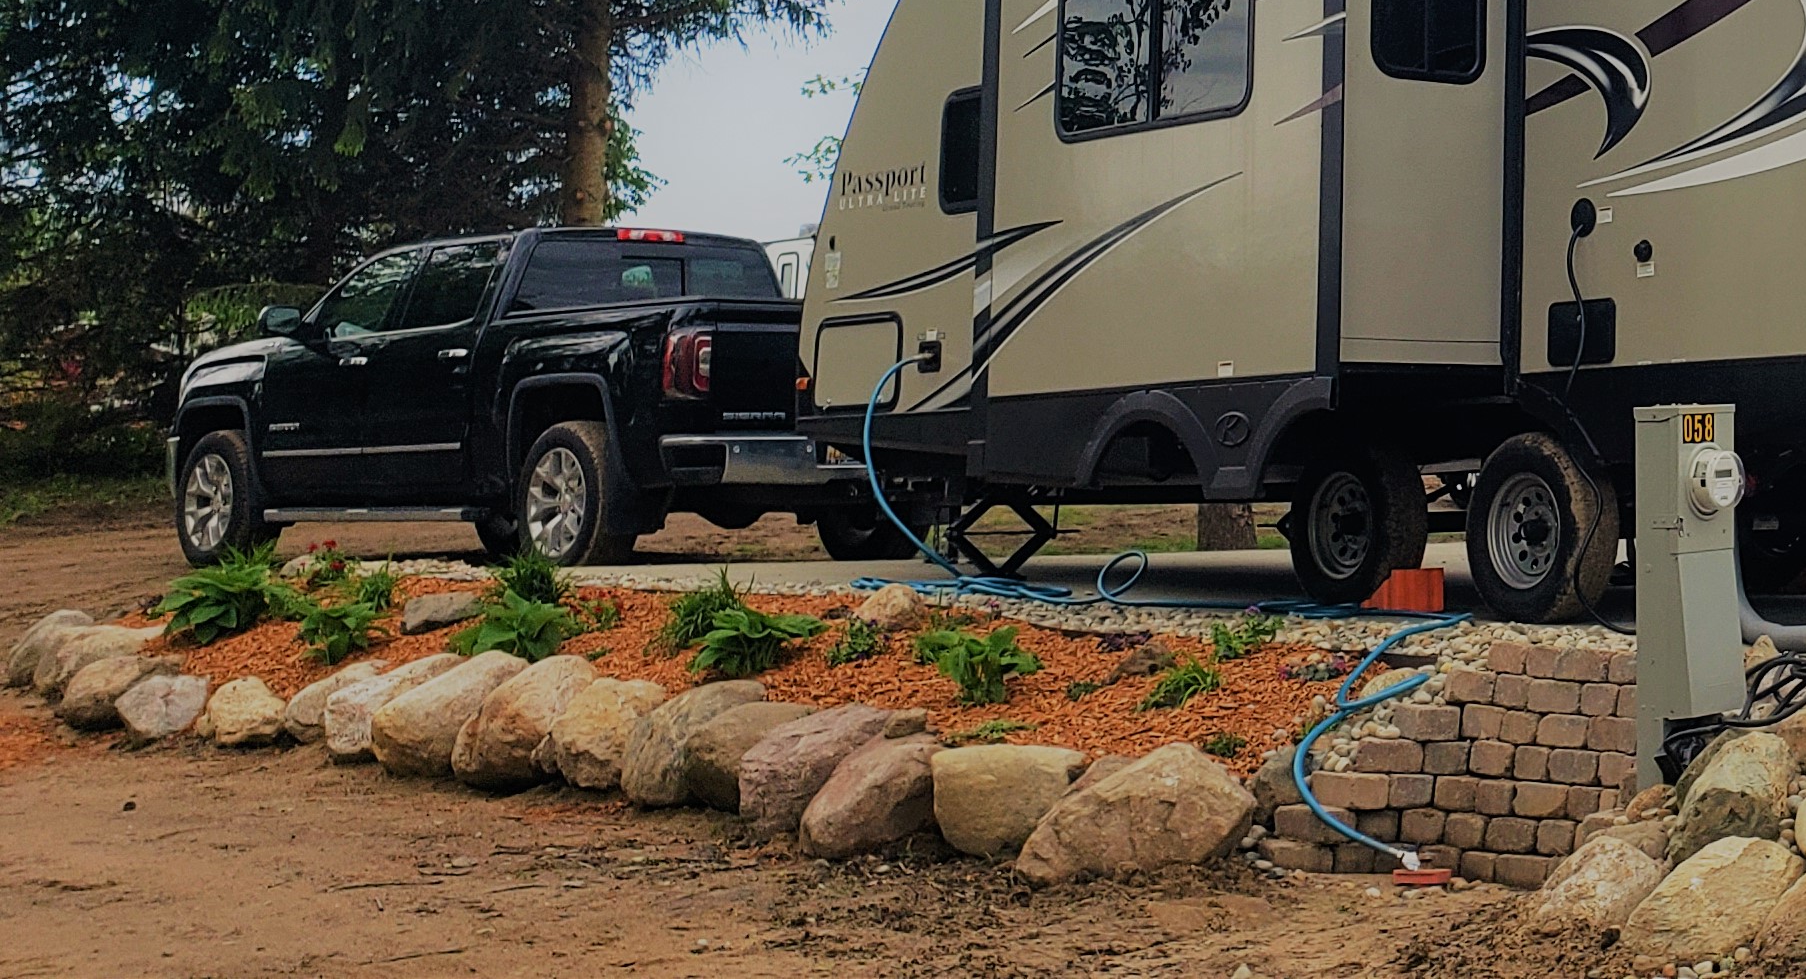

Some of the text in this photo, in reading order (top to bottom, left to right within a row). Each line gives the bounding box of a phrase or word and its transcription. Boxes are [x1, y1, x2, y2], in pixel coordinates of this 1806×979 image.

[841, 161, 926, 196] Passport
[840, 186, 926, 210] ULTRA LITE
[1683, 413, 1713, 443] 058
